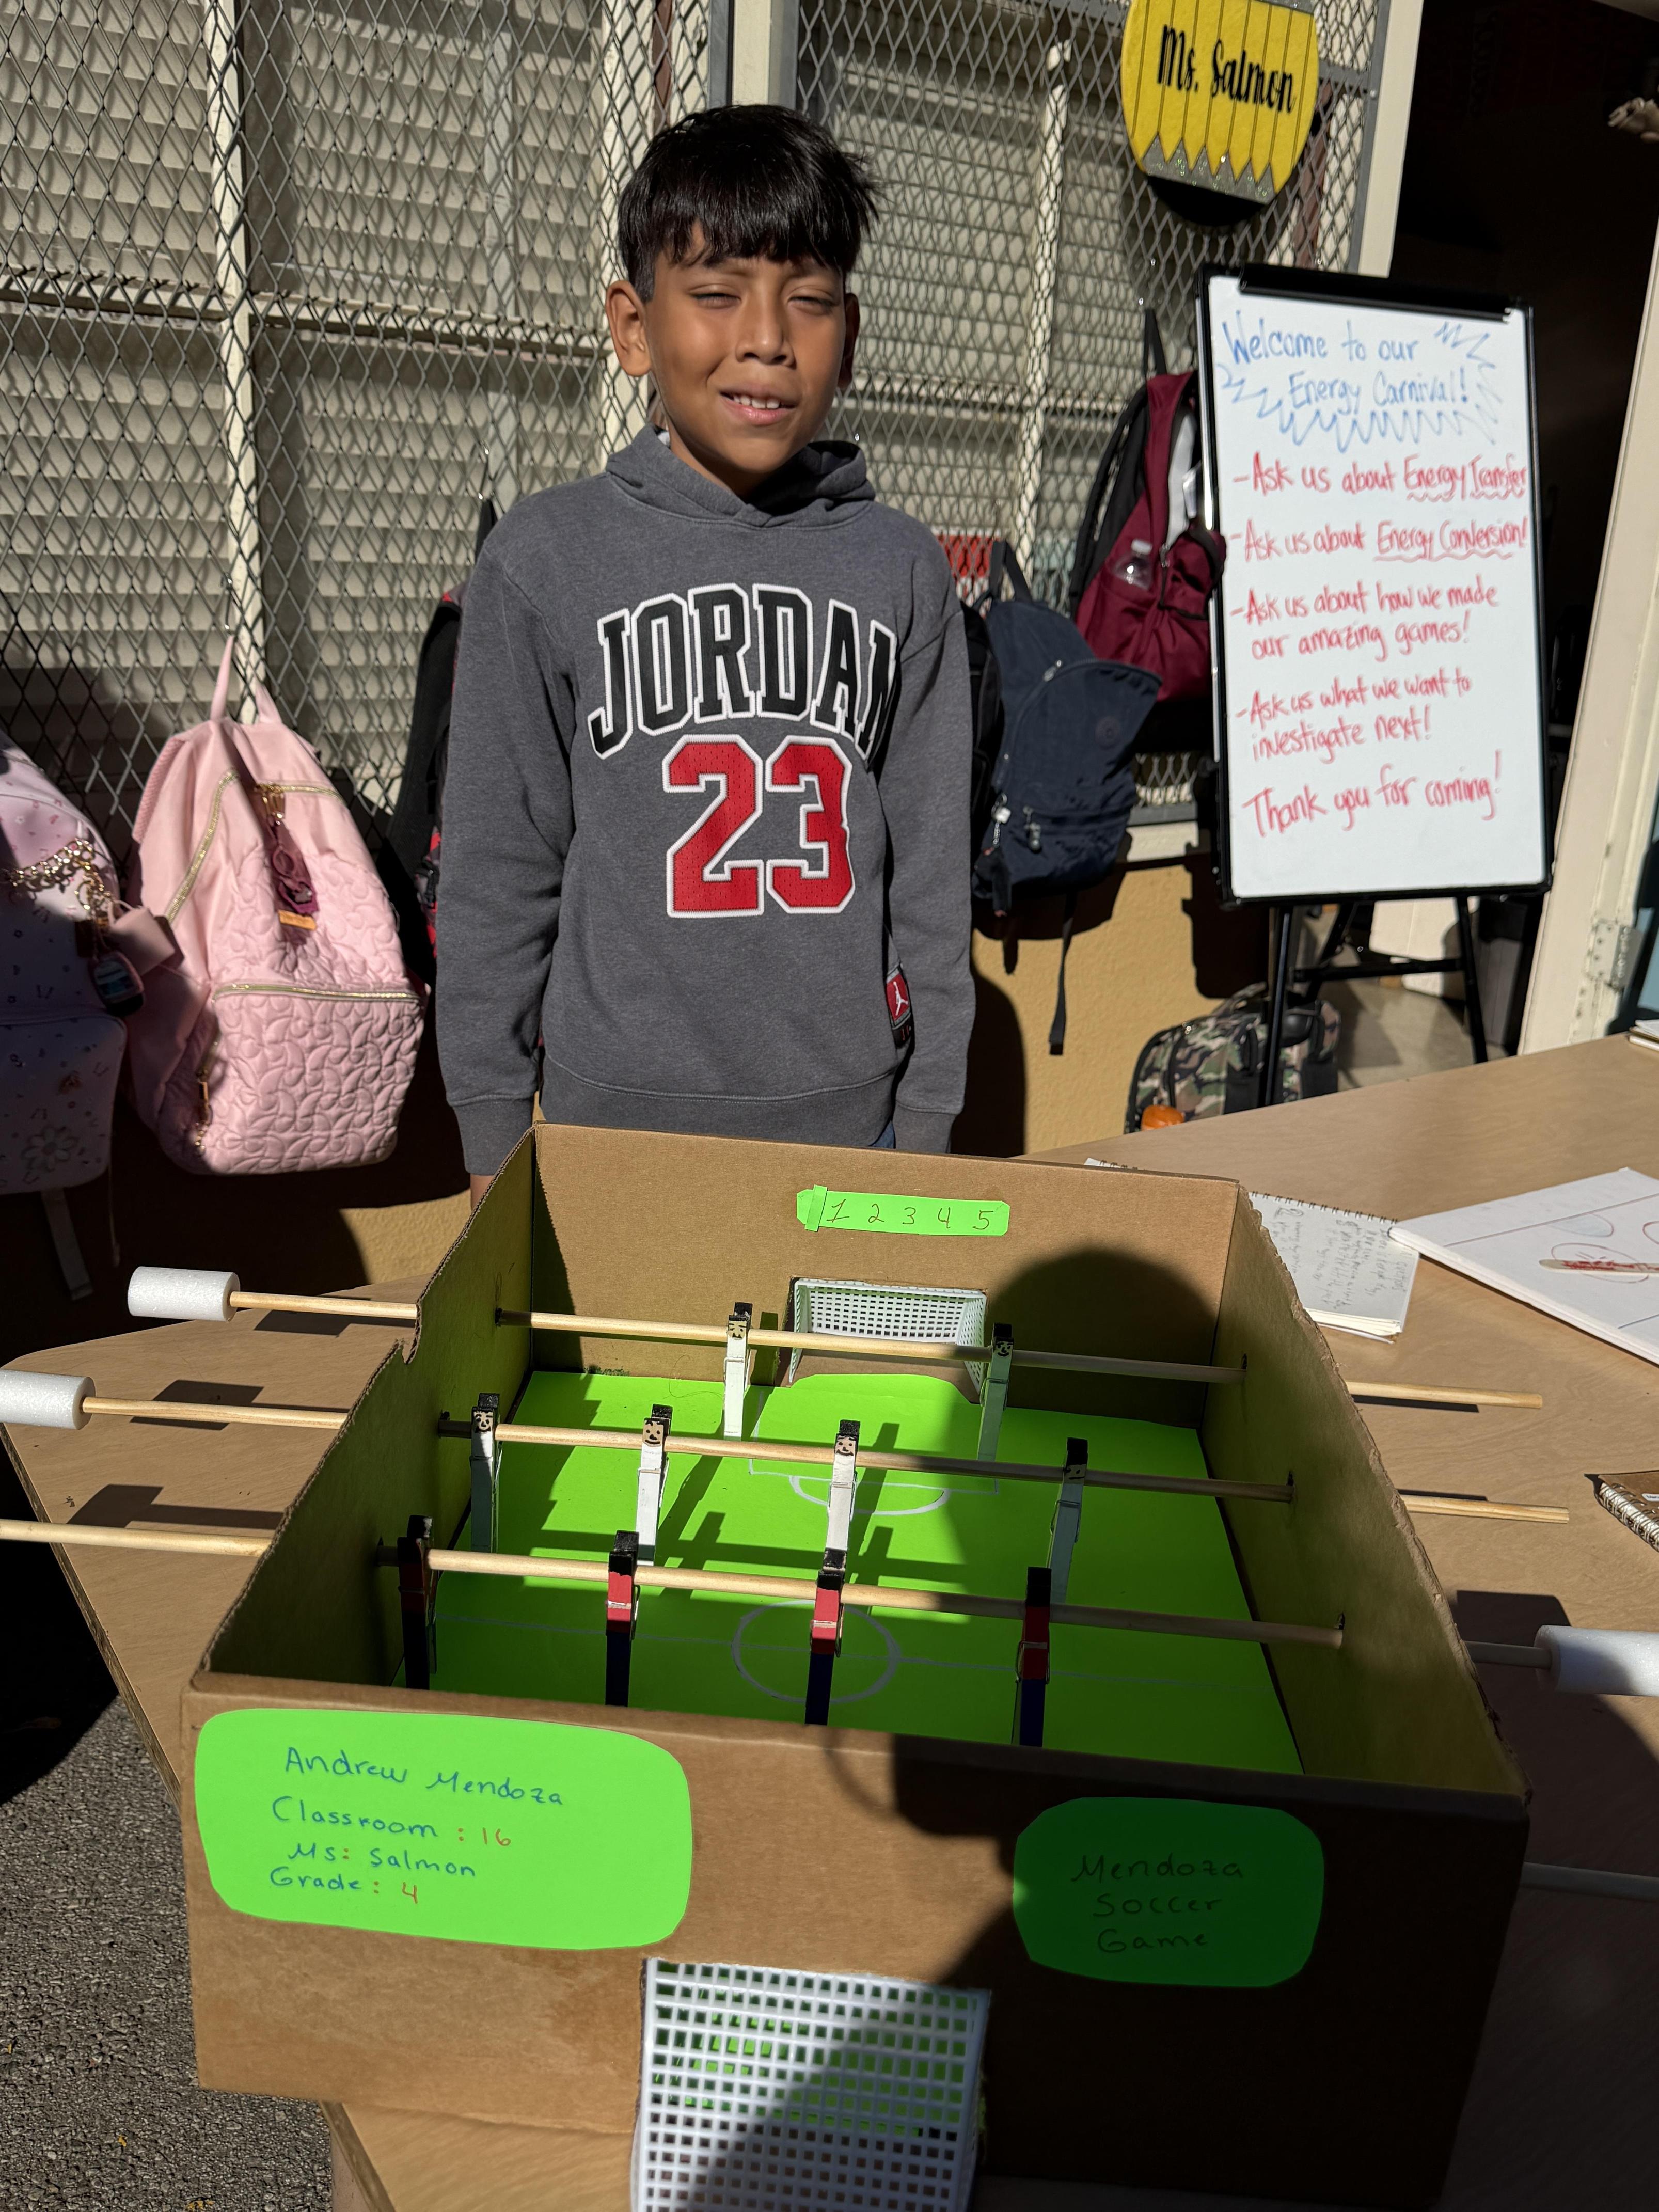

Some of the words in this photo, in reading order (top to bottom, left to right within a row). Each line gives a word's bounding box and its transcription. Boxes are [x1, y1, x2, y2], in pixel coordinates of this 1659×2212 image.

[1158, 24, 1198, 92] Ms.
[1212, 38, 1298, 114] Salmon
[1222, 310, 1328, 365] Welcome
[1341, 319, 1367, 361] to
[1379, 340, 1419, 361] our
[1288, 371, 1361, 414] Energy
[1372, 366, 1469, 407] Carnival!
[1301, 469, 1331, 493] us
[1342, 459, 1396, 493] about
[1403, 453, 1467, 500] Energy
[1285, 533, 1309, 552] us
[1313, 523, 1365, 552] about
[1377, 520, 1434, 559] Energy
[1439, 518, 1528, 558] Conversion!
[1285, 596, 1309, 618] us
[1314, 581, 1368, 613] about
[1376, 581, 1414, 614] how
[1418, 586, 1442, 610] we
[1447, 574, 1499, 608] made
[1251, 636, 1288, 660] our
[1298, 621, 1388, 662] amazing
[1394, 610, 1471, 655] games!
[1291, 694, 1314, 714] us
[1320, 676, 1369, 708] what
[1372, 679, 1400, 699] we
[1404, 667, 1449, 697] want
[1454, 667, 1472, 697] to
[1251, 716, 1366, 764] investigate
[1374, 704, 1432, 741] next!
[1241, 785, 1328, 837] Thank
[1333, 783, 1370, 831] you
[1376, 764, 1417, 807] for
[1424, 750, 1502, 821] coming!
[661, 734, 855, 917] 23
[826, 1199, 850, 1223] 1
[868, 1203, 884, 1223] 2
[903, 1207, 916, 1225] 3
[937, 1207, 951, 1229] 4
[973, 1210, 993, 1230] 5
[285, 1746, 408, 1785] Andrew
[425, 1769, 564, 1807] Mendoza
[272, 1795, 439, 1839] Classroom
[482, 1827, 512, 1847] 16
[370, 1847, 477, 1878] Salmon
[1070, 1853, 1244, 1884] Mendoza
[401, 1883, 419, 1905] 4
[1093, 1892, 1223, 1917] Soccer
[1097, 1928, 1209, 1954] Game
